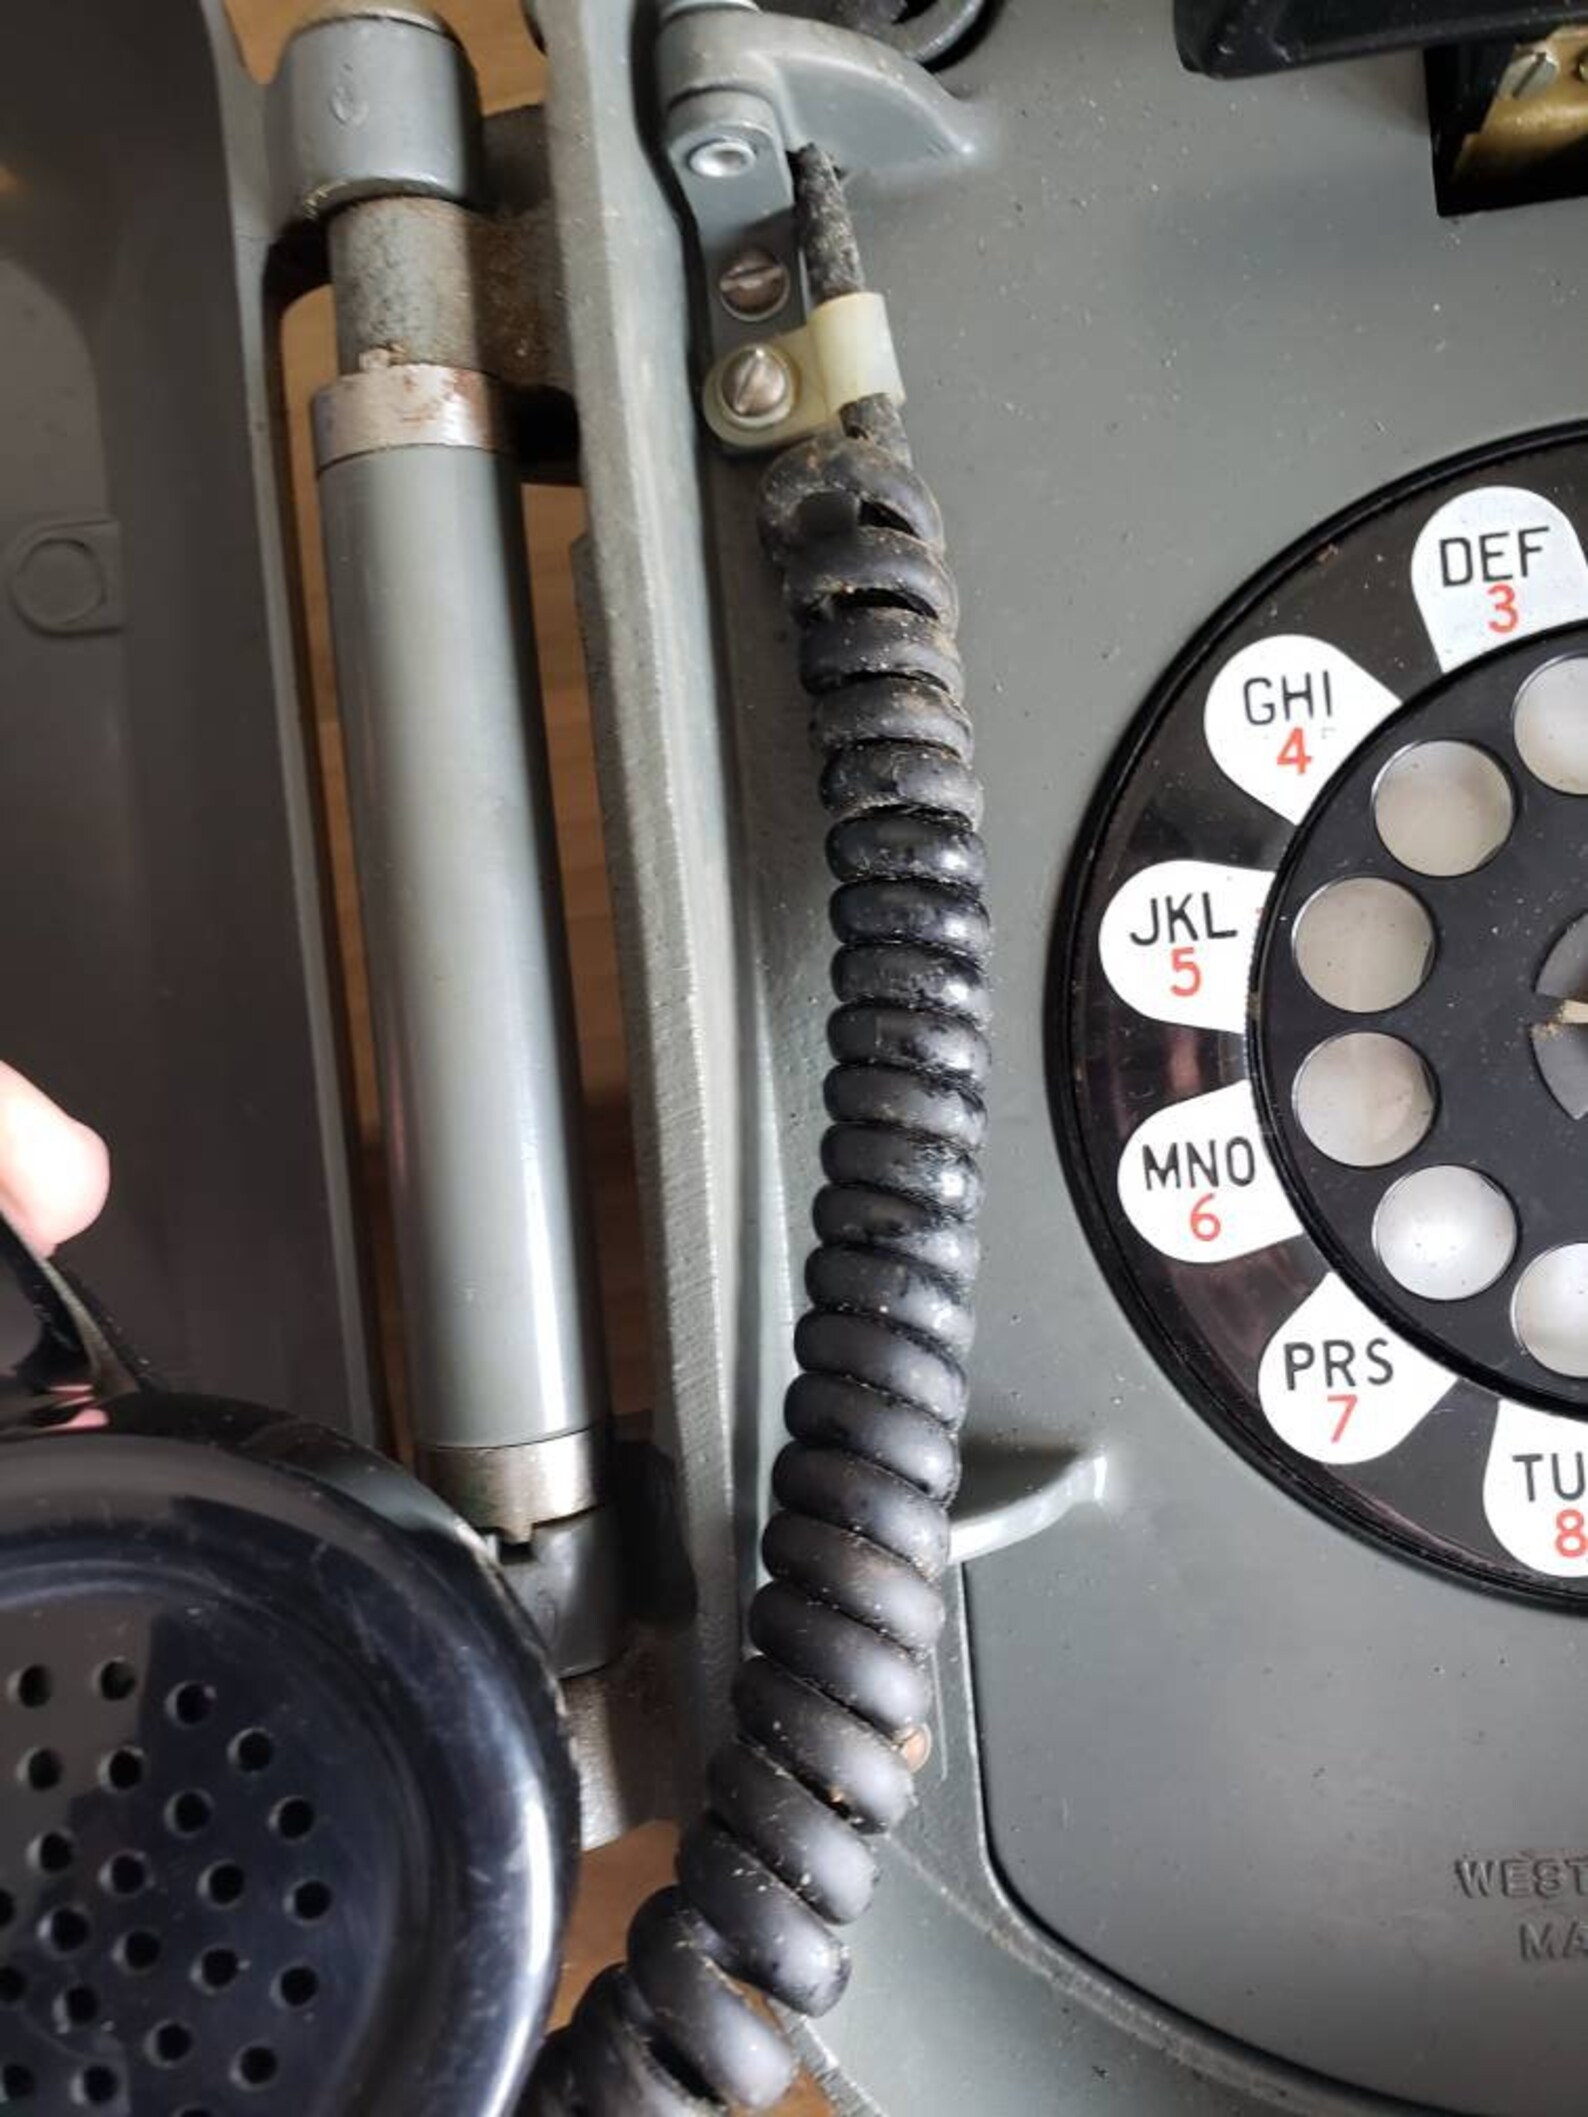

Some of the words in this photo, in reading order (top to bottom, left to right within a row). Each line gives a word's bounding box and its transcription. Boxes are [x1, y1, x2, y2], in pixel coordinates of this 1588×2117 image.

[1439, 526, 1550, 587] DEF
[1487, 582, 1519, 634] 3
[1243, 670, 1332, 726] GHI
[1276, 727, 1312, 775] 4
[1130, 892, 1238, 946] JKL
[1171, 947, 1202, 997] 5
[1142, 1136, 1255, 1190] MNO
[1189, 1194, 1221, 1242] 6
[1284, 1338, 1393, 1391] PRS
[1327, 1394, 1357, 1444] 7
[1555, 1509, 1588, 1558] 8
